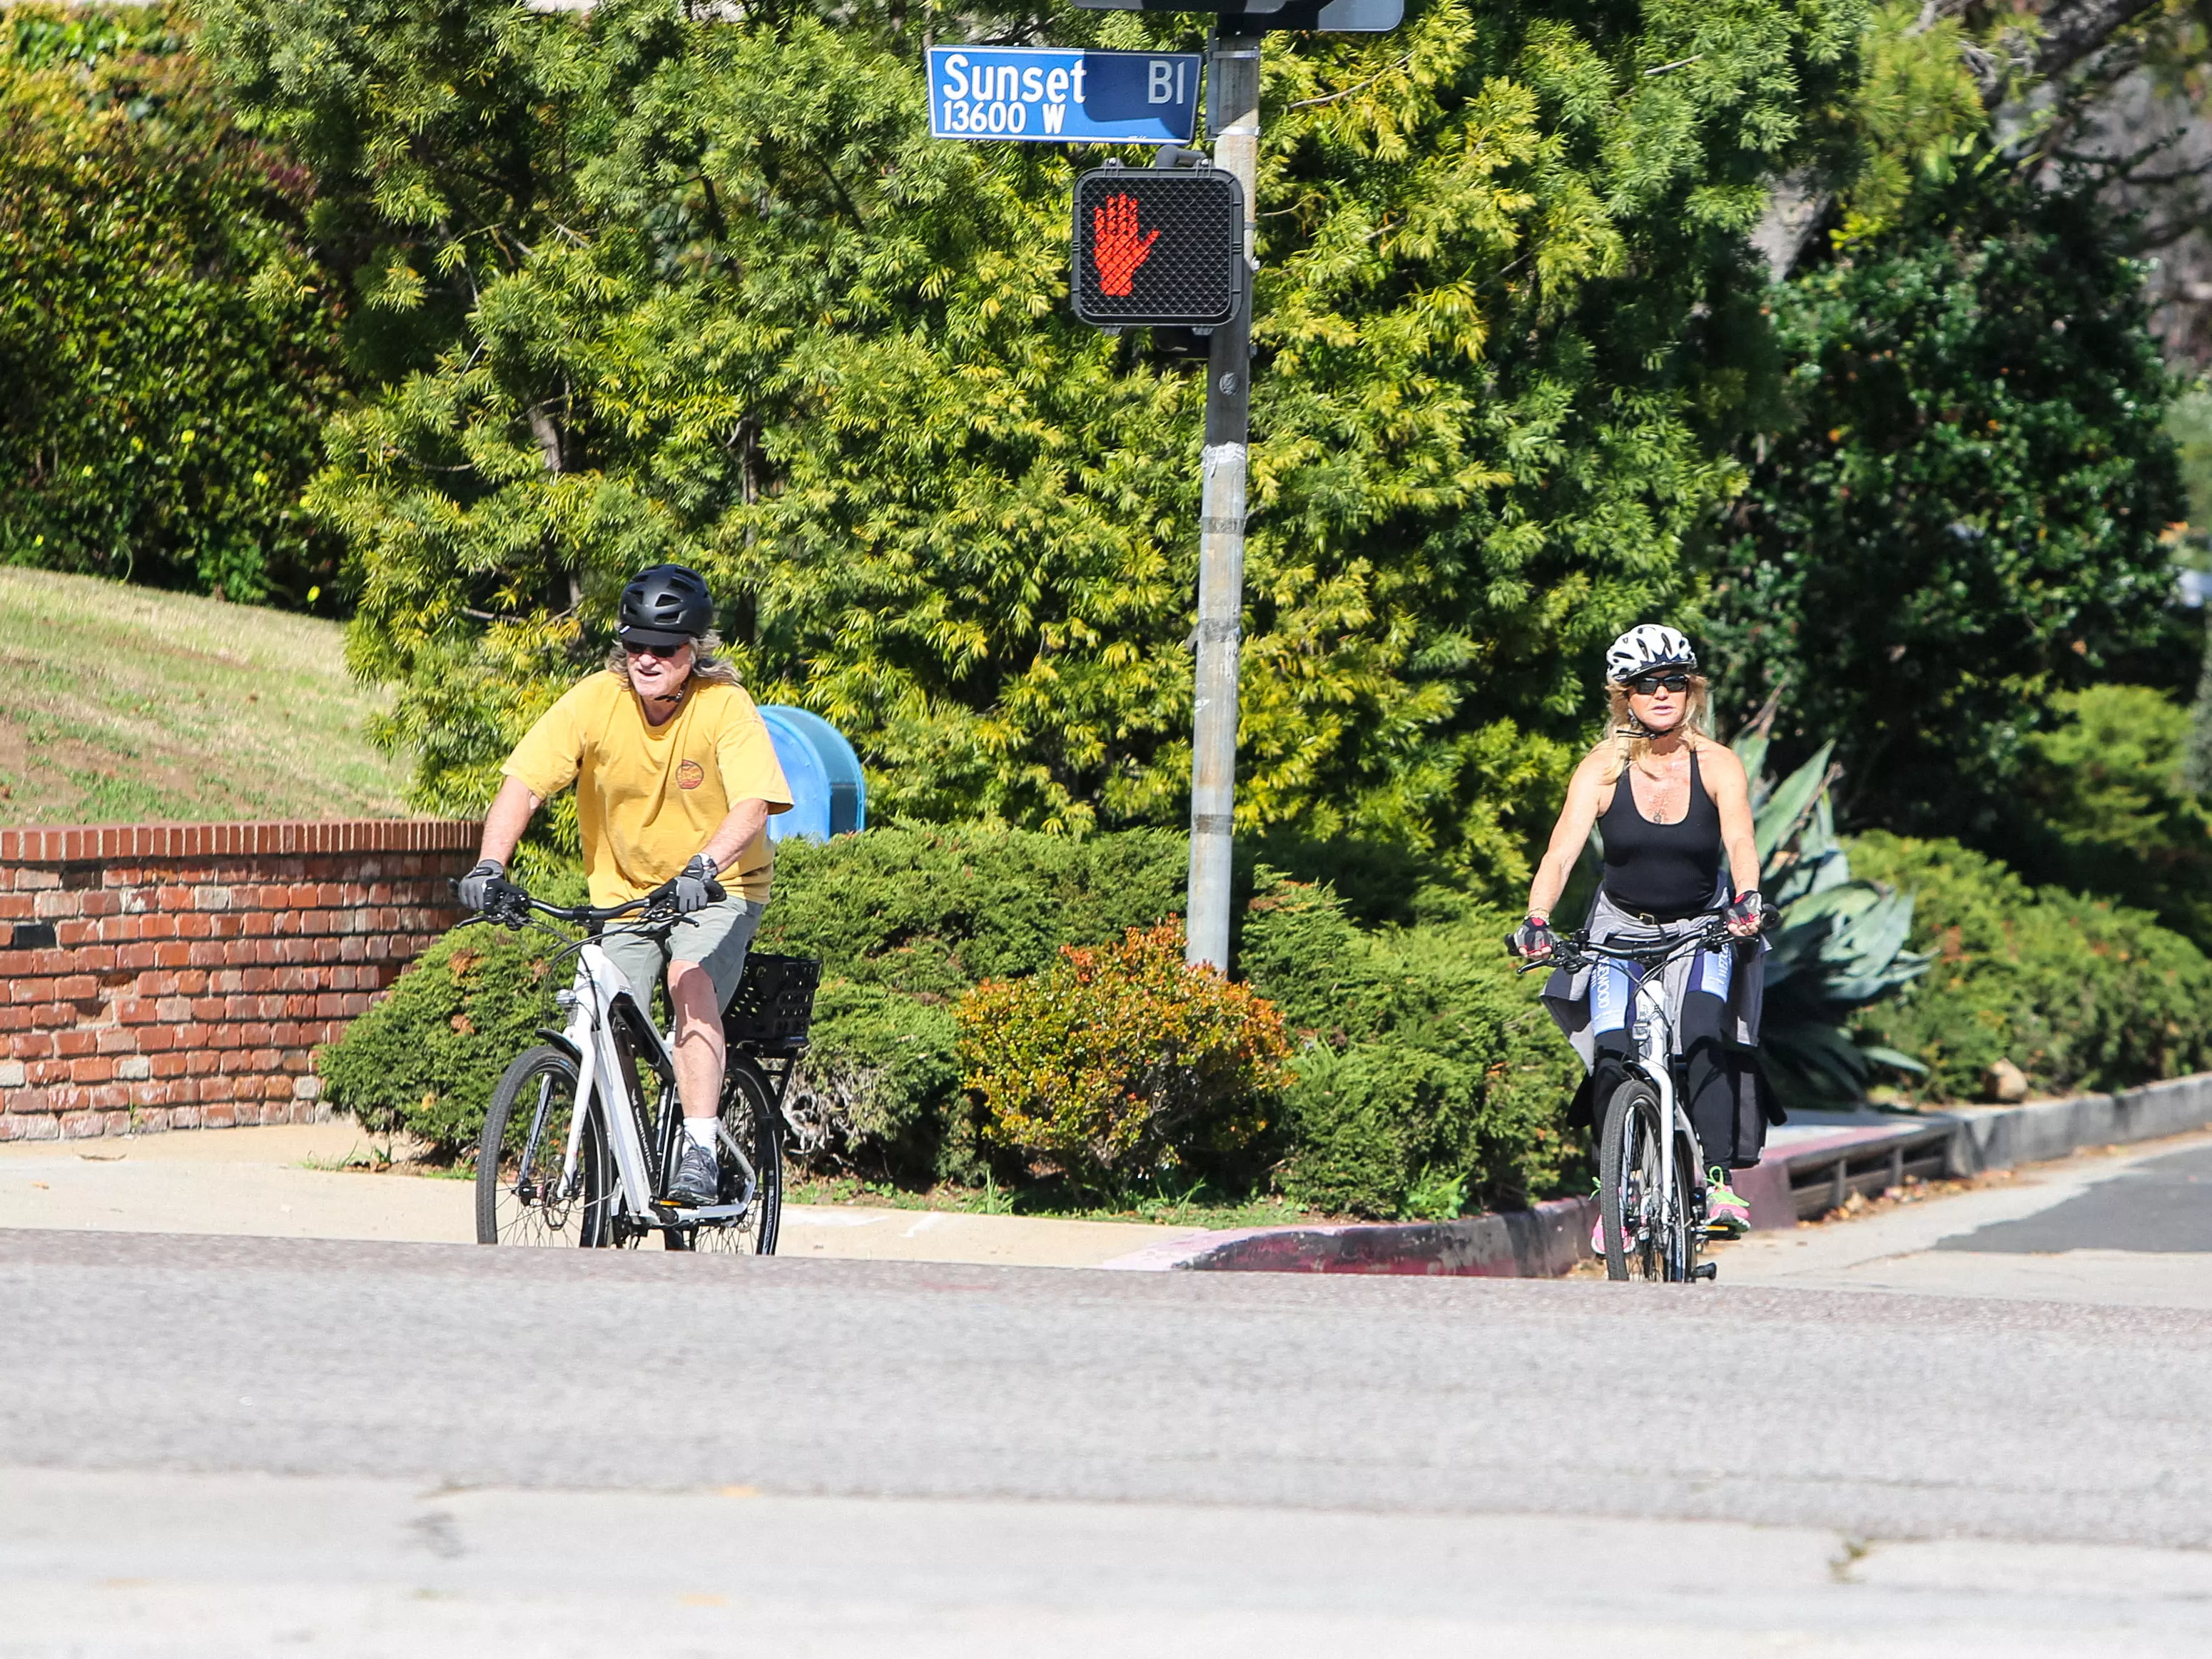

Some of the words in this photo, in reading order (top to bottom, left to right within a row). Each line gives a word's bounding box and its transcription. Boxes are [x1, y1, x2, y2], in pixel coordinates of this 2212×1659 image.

[943, 54, 1087, 104] Sunset
[1147, 59, 1185, 105] Bl
[943, 100, 1027, 133] 13600
[1041, 103, 1066, 134] W
